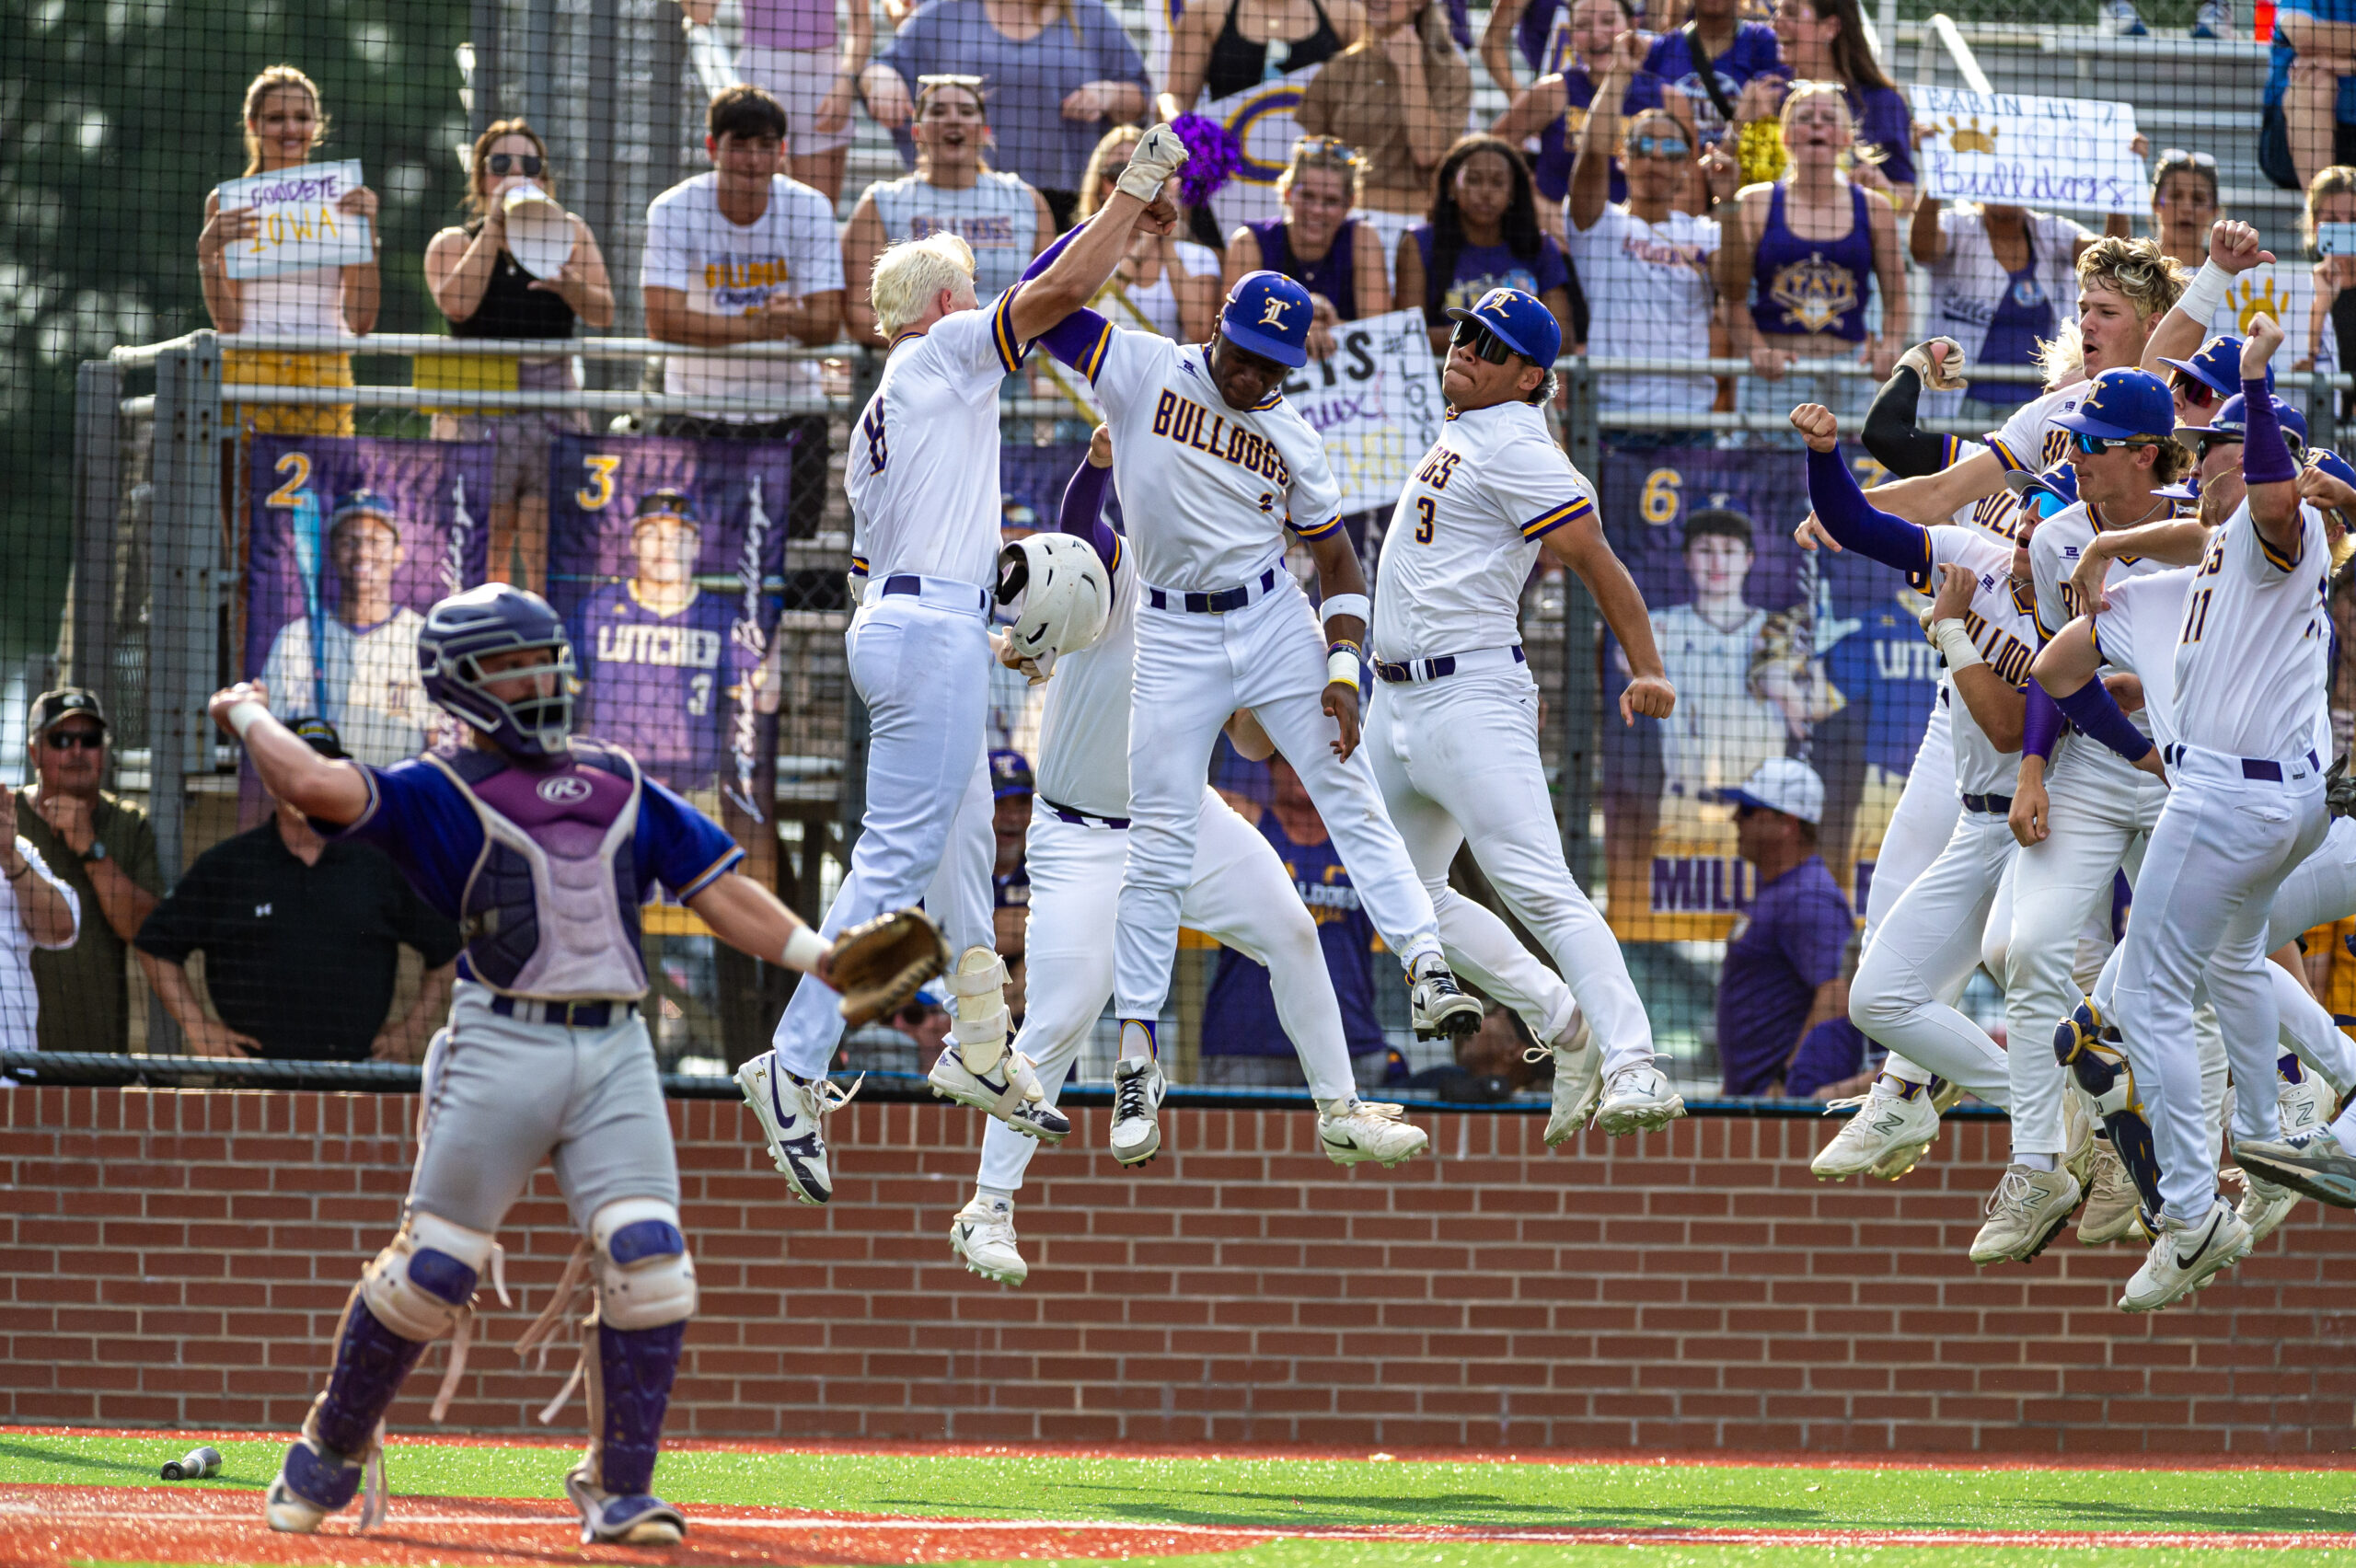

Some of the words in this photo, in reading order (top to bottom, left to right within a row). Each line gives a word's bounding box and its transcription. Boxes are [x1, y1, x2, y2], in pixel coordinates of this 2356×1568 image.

[249, 207, 338, 254] IOWA
[1258, 296, 1291, 331] L
[1151, 386, 1289, 488] BULLDOGS
[265, 451, 312, 508] 2
[575, 454, 622, 512] 3
[1639, 467, 1683, 525] 6
[1415, 497, 1437, 546] 3
[2182, 588, 2213, 645] 11
[687, 673, 713, 717] 3
